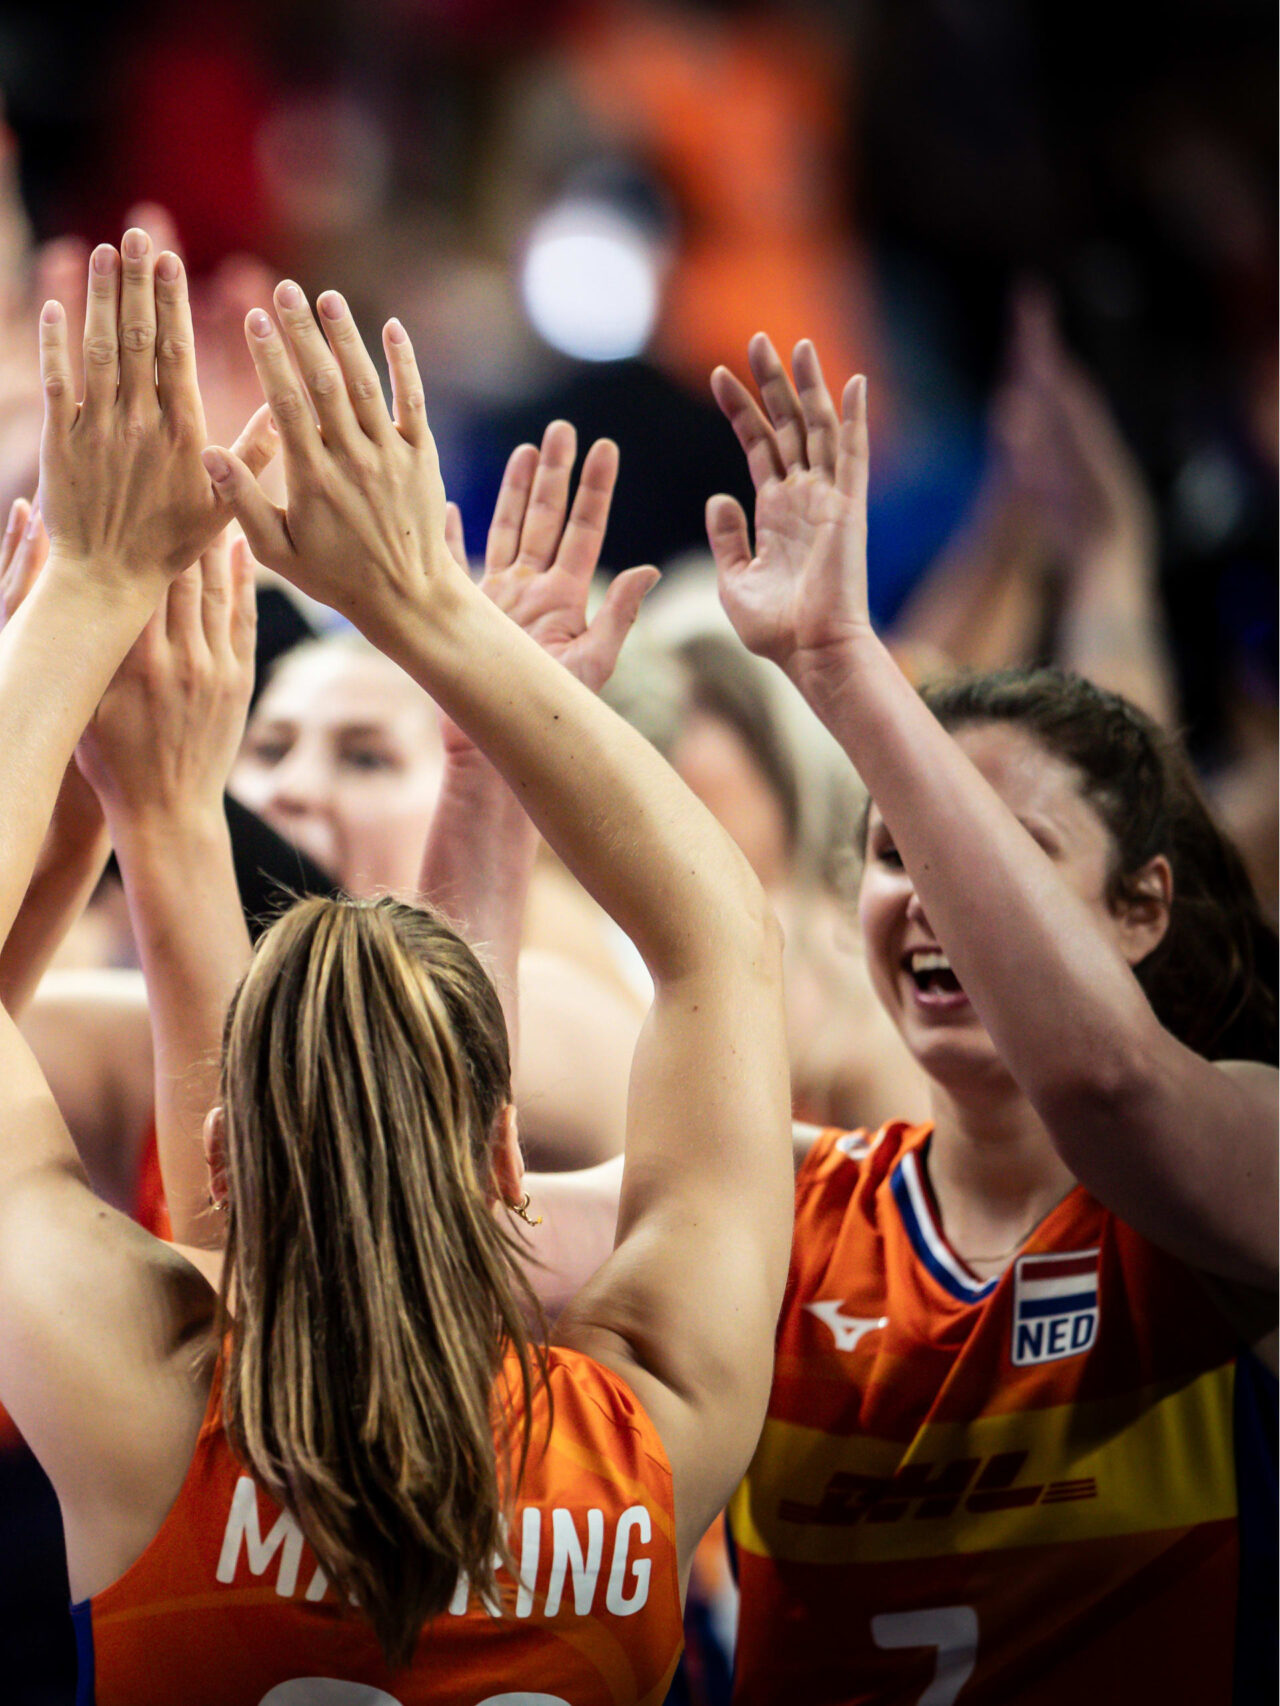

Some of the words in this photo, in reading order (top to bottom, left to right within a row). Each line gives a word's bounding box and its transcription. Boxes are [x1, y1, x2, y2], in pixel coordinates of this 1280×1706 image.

[1017, 1314, 1095, 1360] NED
[216, 1476, 652, 1619] MING
[869, 1605, 980, 1706] 7
